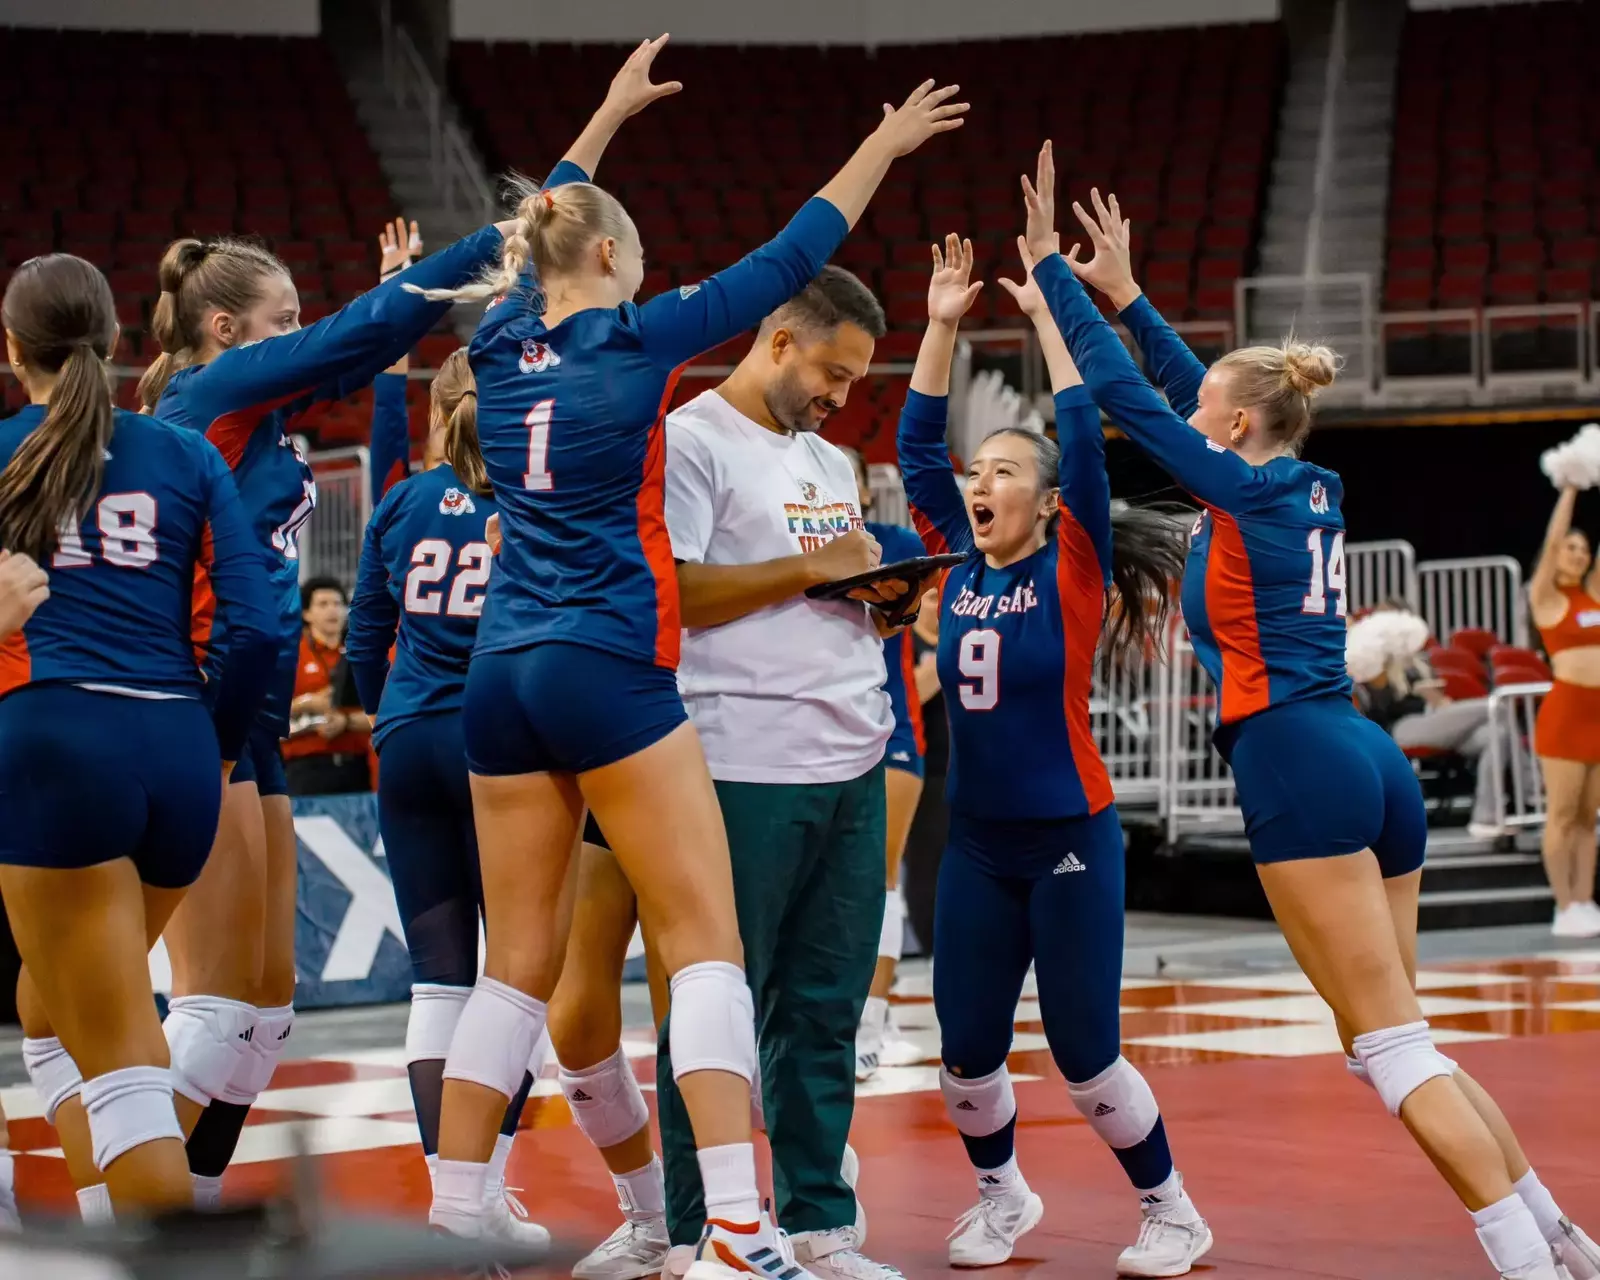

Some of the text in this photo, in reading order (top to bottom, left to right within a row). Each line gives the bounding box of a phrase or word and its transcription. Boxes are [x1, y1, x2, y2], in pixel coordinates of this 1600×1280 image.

[523, 398, 556, 491] 1
[52, 492, 159, 568] 18
[404, 538, 492, 618] 22
[1301, 528, 1348, 617] 14
[958, 627, 1002, 712] 9
[1053, 864, 1086, 875] adidas
